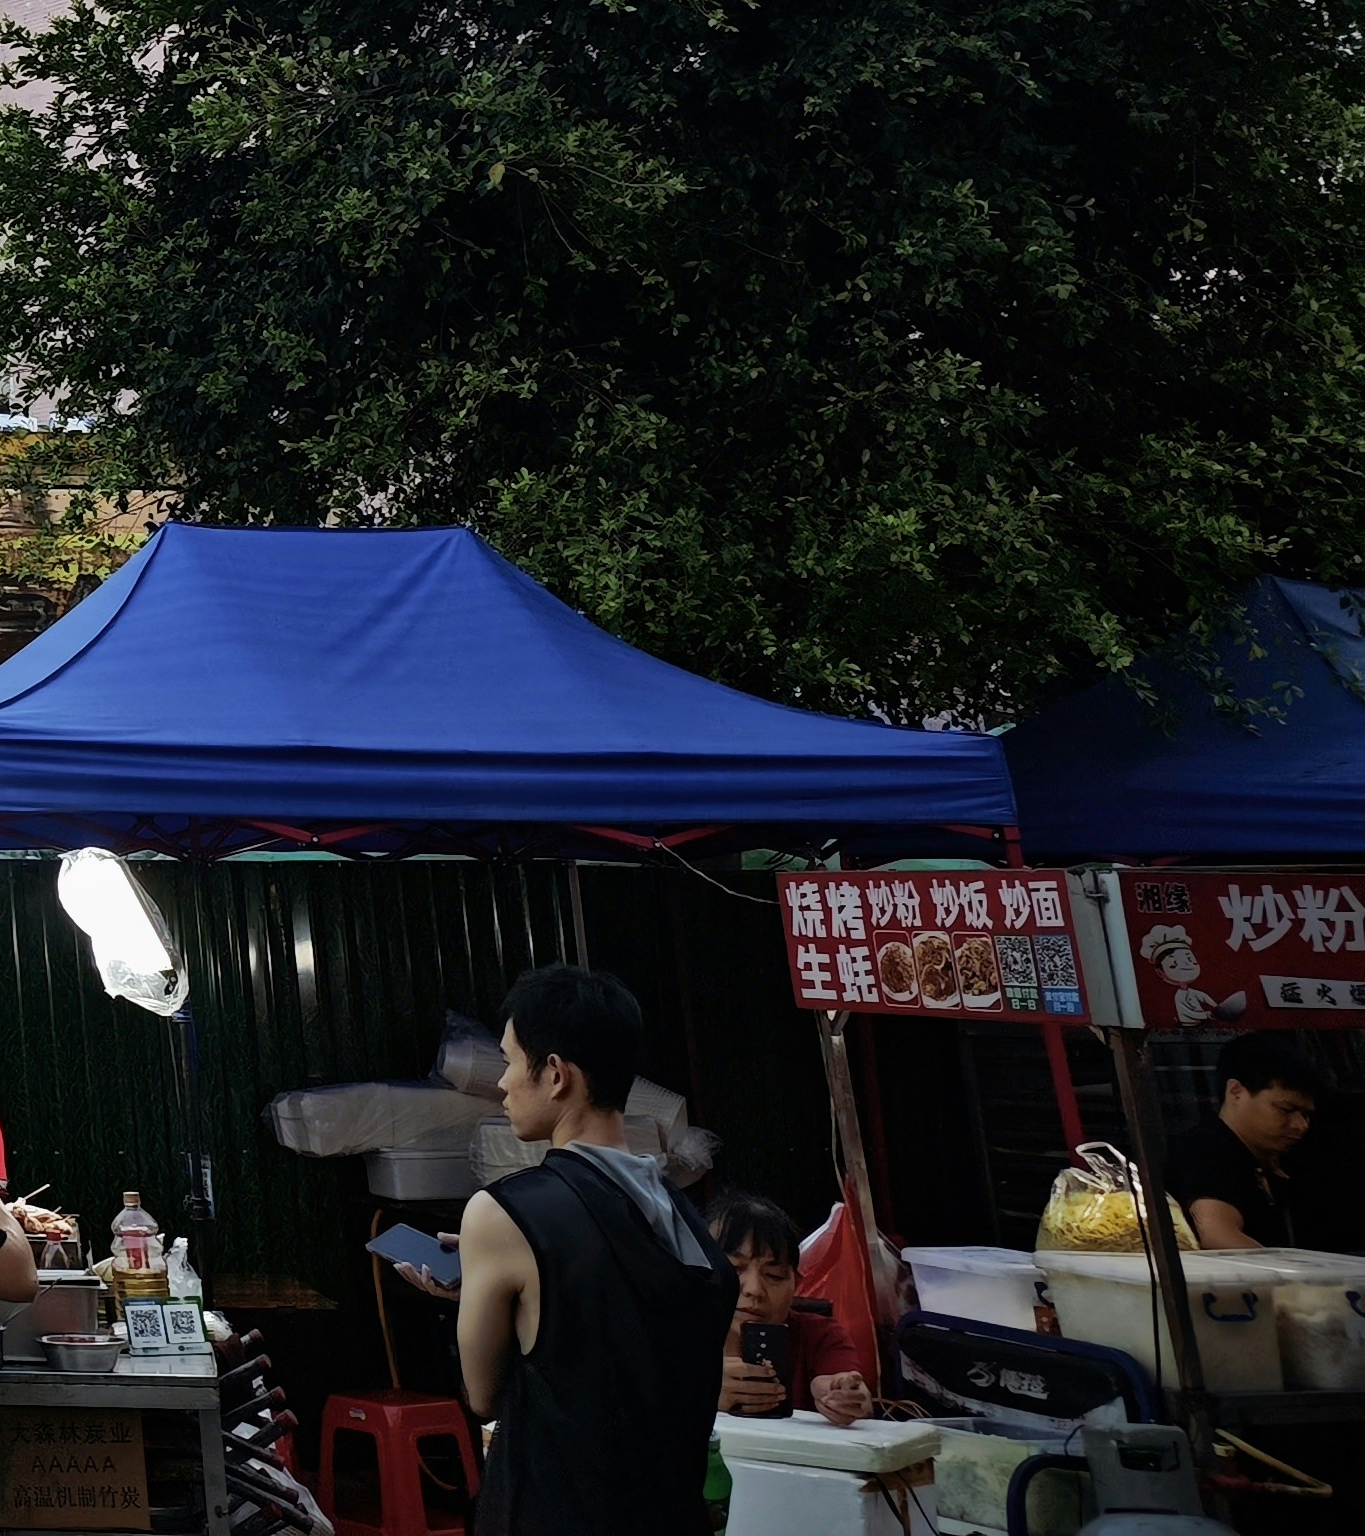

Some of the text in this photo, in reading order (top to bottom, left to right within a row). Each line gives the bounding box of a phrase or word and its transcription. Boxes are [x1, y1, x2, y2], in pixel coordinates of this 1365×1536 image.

[785, 878, 1066, 941] 烧烤 炒粉 炒饭 炒面
[1135, 882, 1192, 914] 湘缘
[1218, 884, 1365, 953] 炒粉
[796, 943, 880, 1004] 生蚝
[14, 1485, 141, 1510] 高温机制竹炭
